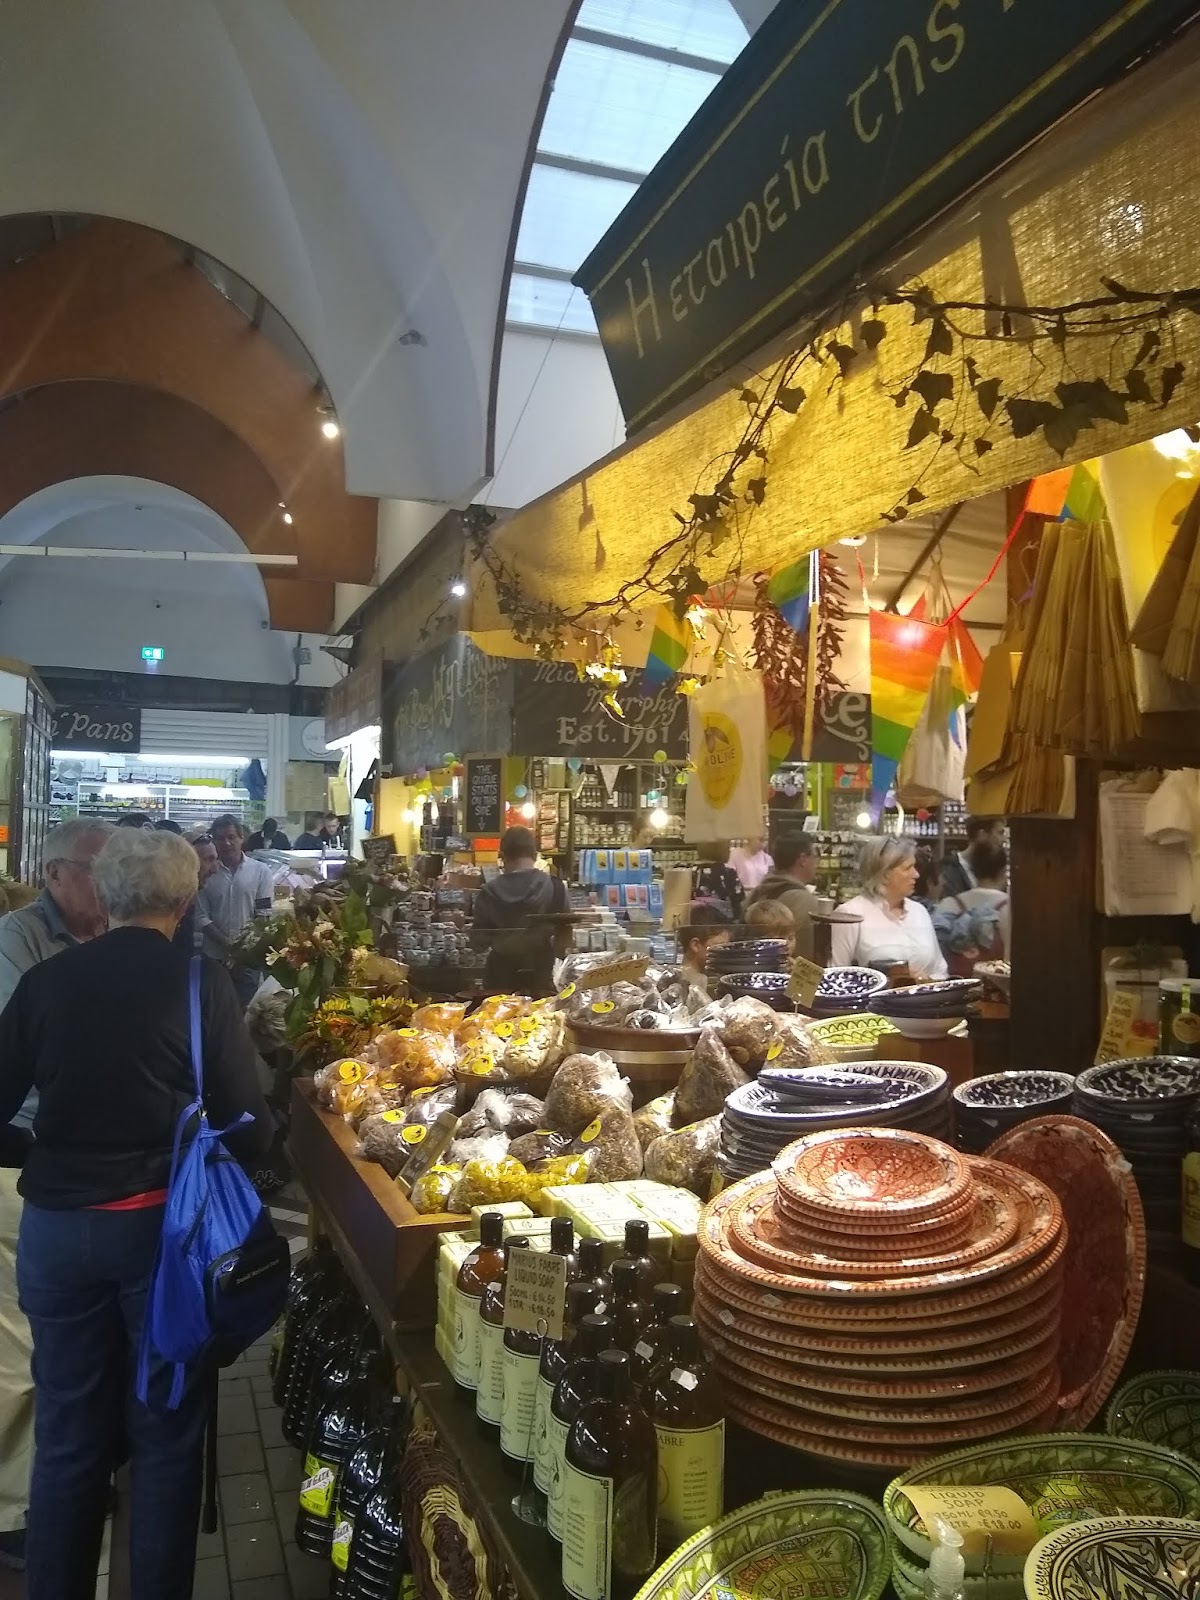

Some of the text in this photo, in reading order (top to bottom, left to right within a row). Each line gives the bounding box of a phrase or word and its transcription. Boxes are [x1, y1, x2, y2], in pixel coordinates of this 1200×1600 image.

[582, 686, 684, 726] Mrphy
[66, 711, 134, 743] Pans
[556, 716, 617, 745] Est.
[476, 765, 492, 774] THE
[472, 774, 498, 785] QUEUE
[471, 784, 498, 796] STARTS
[471, 796, 481, 805] ON
[474, 805, 492, 816] SIDE
[539, 1259, 561, 1274] FABRE
[514, 1267, 556, 1288] LIQUID SOAP
[659, 1435, 687, 1447] ABRE
[930, 1491, 985, 1499] LIQUID
[943, 1499, 984, 1509] SOAP
